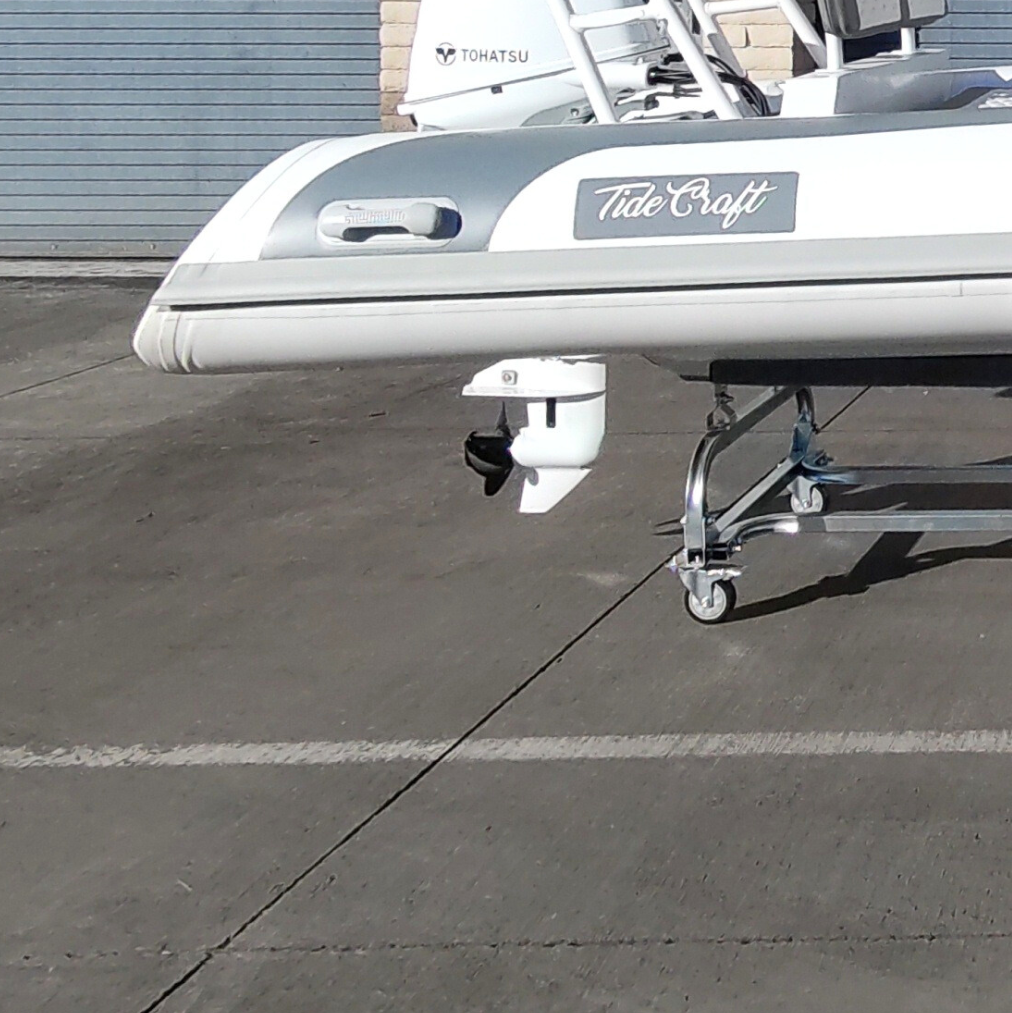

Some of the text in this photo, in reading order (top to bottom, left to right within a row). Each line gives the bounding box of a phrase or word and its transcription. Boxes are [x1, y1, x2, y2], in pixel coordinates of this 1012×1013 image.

[461, 49, 529, 63] TOHATSU
[595, 177, 778, 229] Tide Craft
